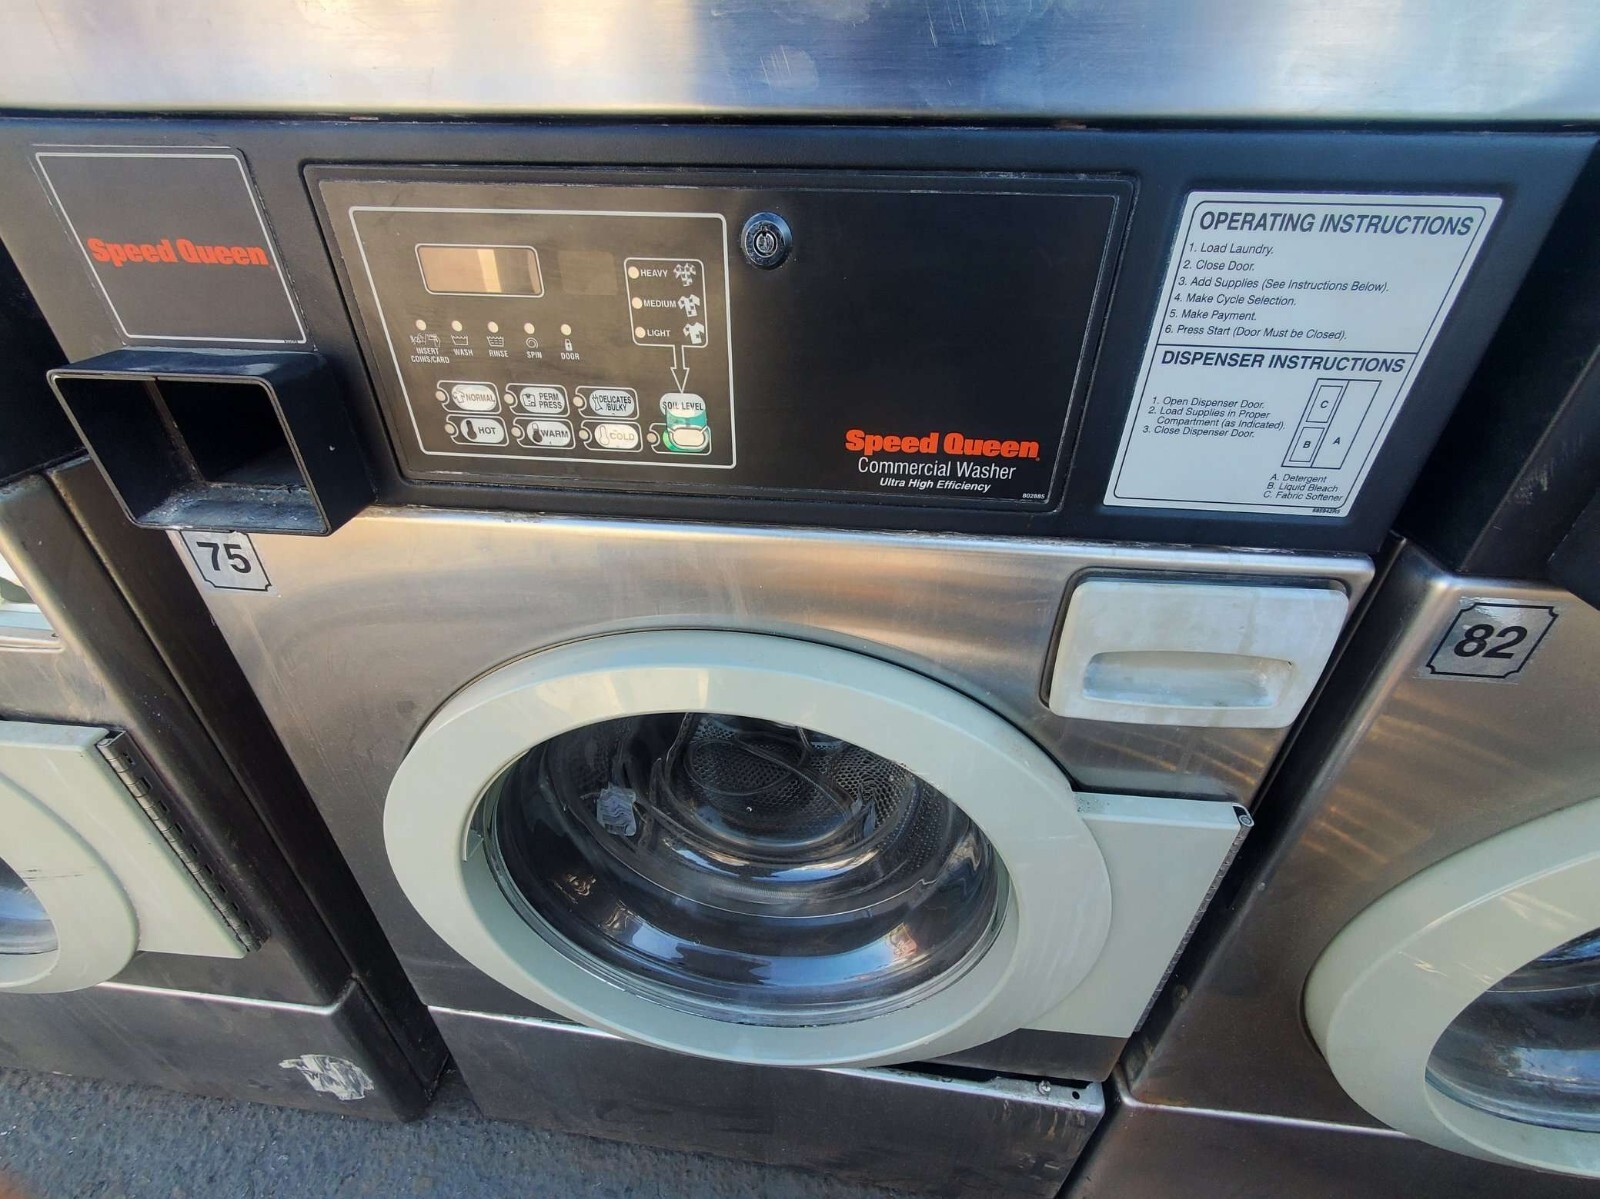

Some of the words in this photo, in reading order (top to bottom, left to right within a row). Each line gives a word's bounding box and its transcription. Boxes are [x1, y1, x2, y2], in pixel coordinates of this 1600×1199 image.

[1200, 211, 1315, 233] OPERATING
[1319, 214, 1474, 236] INSTRUCTIONS
[87, 237, 179, 268] Speed
[175, 238, 269, 266] Queen
[1189, 243, 1197, 253] 1.
[1201, 243, 1227, 254] Load
[1229, 244, 1274, 257] Laundry.
[1183, 261, 1192, 270] 2.
[1195, 260, 1224, 271] Close
[1227, 261, 1255, 271] Door.
[641, 269, 668, 277] HEAVY
[1178, 277, 1187, 286] 3.
[1190, 277, 1212, 288] Add
[1215, 278, 1259, 291] Supplies
[1261, 278, 1285, 290] (See
[1288, 280, 1348, 292] Instructions
[1351, 281, 1389, 294] Below).
[644, 300, 676, 308] MEDIUM
[1173, 294, 1182, 303] 4.
[1186, 294, 1213, 304] Make
[1216, 294, 1244, 307] Cycle
[1247, 295, 1296, 307] Selection.
[1169, 309, 1178, 319] 5.
[1181, 309, 1209, 320] Make
[1211, 310, 1257, 323] Payment.
[1164, 324, 1173, 334] 6.
[1177, 325, 1205, 336] Press
[1208, 326, 1230, 337] Start
[1232, 326, 1262, 338] (Door
[1264, 327, 1289, 338] Must
[1291, 328, 1303, 339] be
[1306, 328, 1347, 341] Closed).
[489, 350, 509, 358] RINSE
[526, 351, 543, 359] SPIN
[561, 352, 580, 360] DOOR
[1161, 351, 1264, 368] DISPENSER
[1268, 355, 1406, 373] INSTRUCTIONS
[466, 394, 495, 403] NORMAL
[539, 392, 559, 401] PERM
[599, 395, 632, 404] DELICATES
[539, 401, 563, 409] PRESS
[662, 401, 679, 409] SOIL
[682, 402, 703, 410] LEVEL
[1163, 397, 1188, 407] Open
[1190, 397, 1238, 410] Dispenser
[1240, 399, 1265, 409] Door.
[1320, 401, 1328, 409] C
[1148, 406, 1156, 414] 2.
[1159, 406, 1183, 416] Load
[1186, 407, 1225, 419] Supplies
[1227, 409, 1236, 418] in
[1238, 410, 1270, 420] Proper
[1157, 416, 1219, 428] Compartment
[1221, 418, 1235, 428] (as
[1237, 419, 1285, 430] Indicated).
[478, 427, 496, 435] HOT
[541, 430, 569, 439] WARM
[610, 432, 635, 441] COLD
[1143, 426, 1151, 434] 3.
[1154, 426, 1180, 435] Close
[1182, 426, 1229, 438] Dispenser
[1230, 428, 1255, 438] Door.
[845, 429, 939, 455] Speed
[943, 432, 1039, 458] Queen
[1303, 441, 1311, 449] B
[1333, 437, 1341, 445] A
[858, 456, 951, 476] Commercial
[957, 461, 1016, 479] Washer
[1283, 474, 1327, 484] Detergent
[880, 477, 906, 487] Ultra
[908, 479, 933, 489] High
[936, 480, 991, 493] Efficiency
[1267, 482, 1275, 490] B.
[1279, 483, 1306, 493] Liquid
[1308, 483, 1338, 492] Bleach
[1263, 490, 1272, 498] C.
[1276, 491, 1303, 500] Fabric
[1305, 493, 1343, 501] Softener
[197, 541, 252, 574] 75
[1454, 624, 1527, 659] 82
